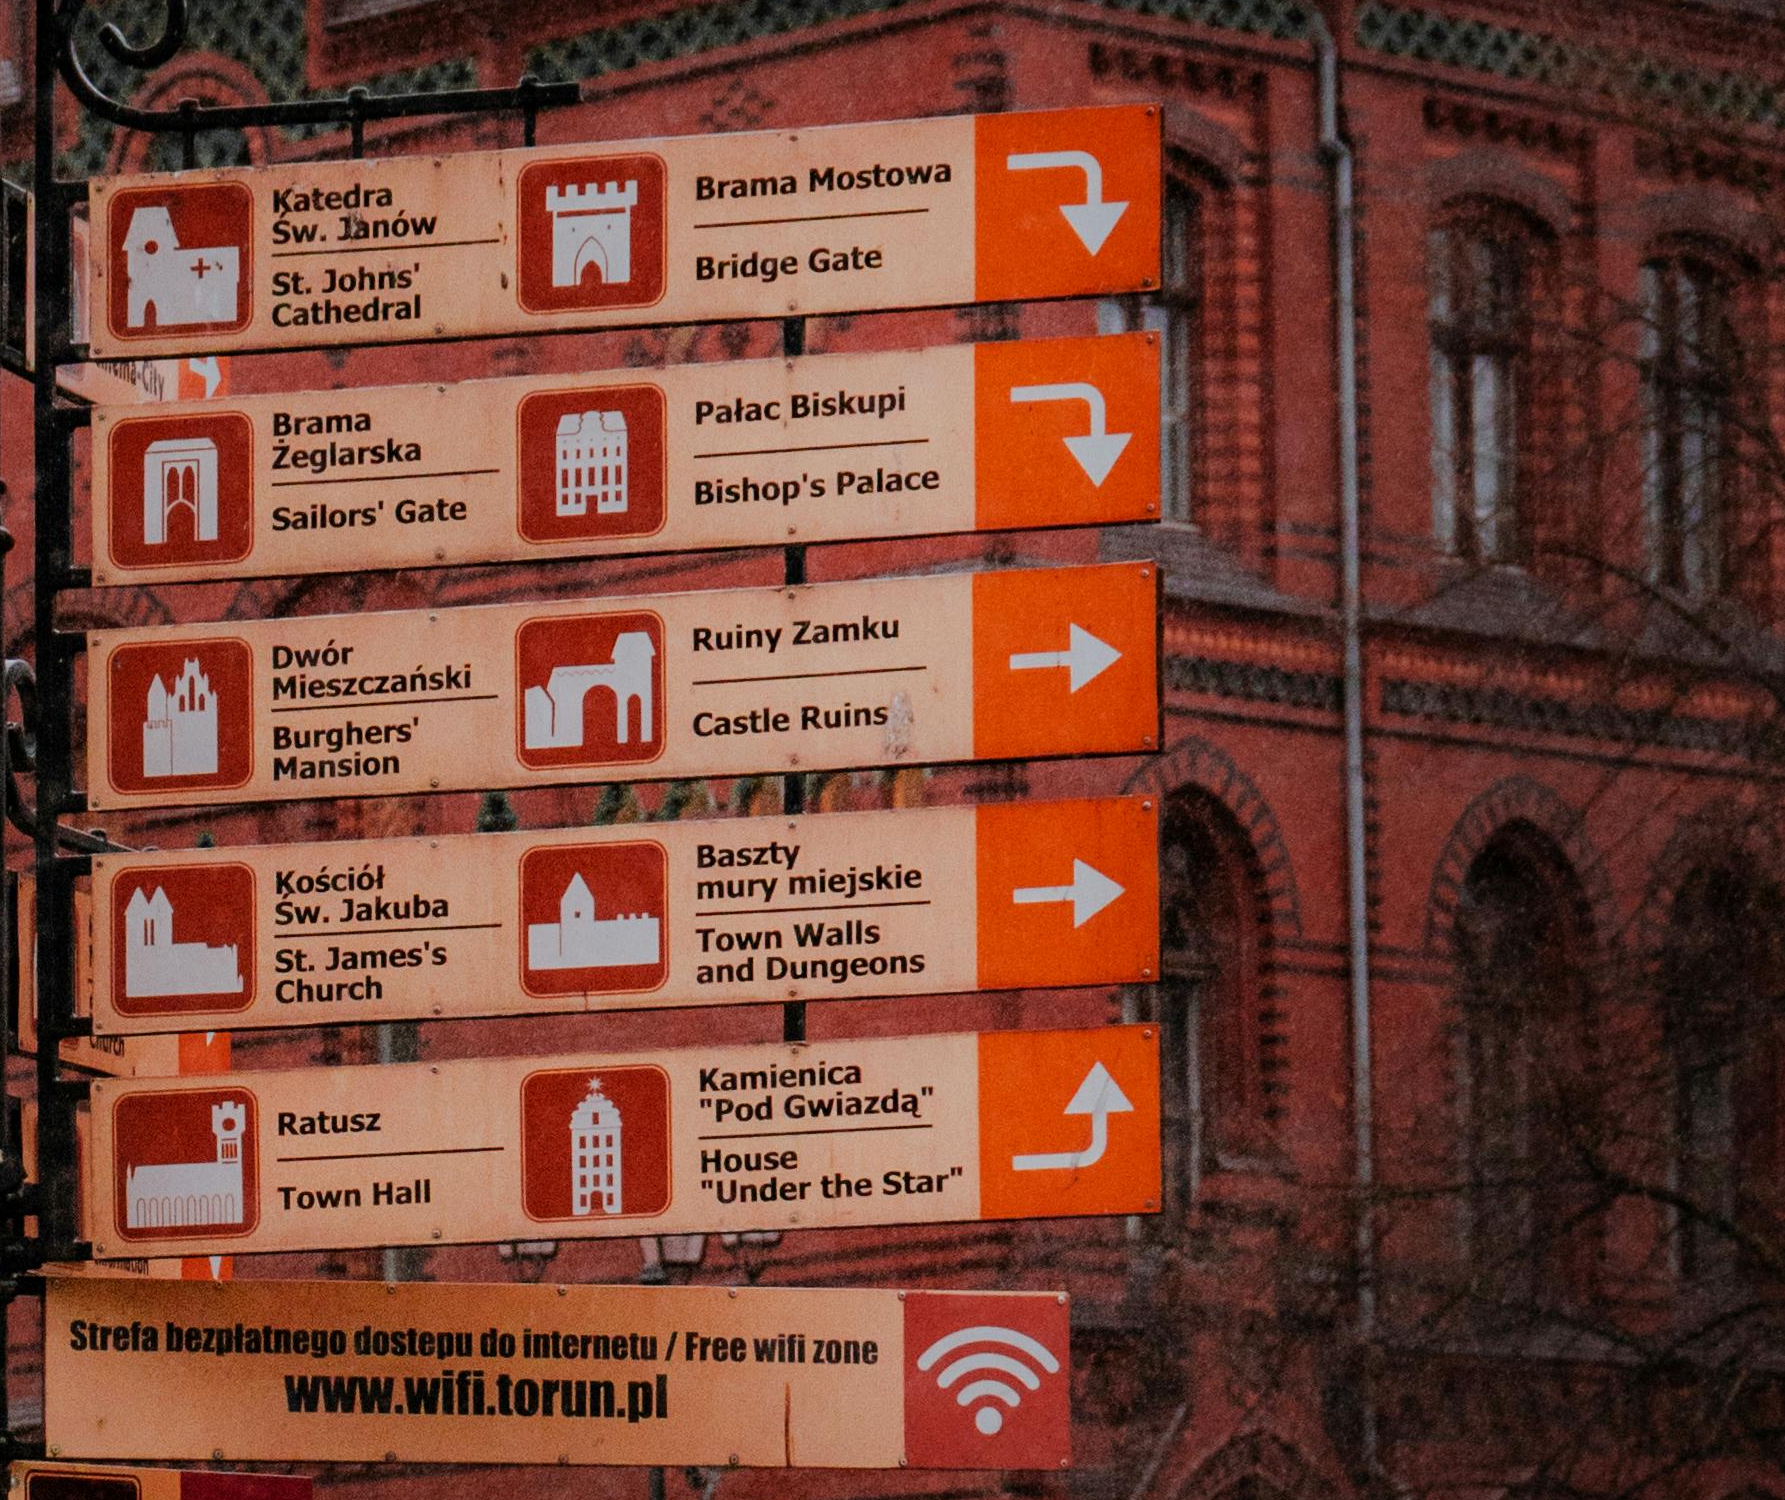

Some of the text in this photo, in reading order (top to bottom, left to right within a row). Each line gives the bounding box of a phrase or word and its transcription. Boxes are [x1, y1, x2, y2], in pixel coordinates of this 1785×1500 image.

[697, 164, 951, 200] Brama Mostowa
[274, 183, 392, 214] Katedra
[273, 210, 436, 244] Św. Janów
[272, 263, 419, 296] St. Johns'
[697, 247, 881, 282] Bridge Gate
[272, 295, 420, 327] Cathedral
[696, 386, 904, 424] Pałac Biskupi
[274, 413, 370, 436] Brama
[272, 438, 421, 473] Żeglarska
[695, 468, 939, 505] Bishop's Palace
[273, 499, 466, 531] Sailors' Gate
[694, 616, 898, 653] Ruiny Zamku
[273, 640, 353, 669] Dwór
[273, 664, 470, 700] Mieszczański
[693, 703, 888, 736] Castle Ruins
[274, 717, 418, 756] Burghers'
[274, 752, 399, 780] Mansion
[698, 842, 800, 870] Baszty
[276, 864, 385, 895] Kościół
[698, 865, 921, 902] mury miejskie
[276, 893, 448, 925] Św. Jakuba
[696, 920, 880, 952] Town Walls
[276, 942, 446, 973] St. James's
[697, 955, 924, 984] and Dungeons
[276, 976, 382, 1003] Church
[700, 1062, 861, 1092] Kamienica
[700, 1087, 933, 1122] "Pod Gwiazdą"
[279, 1112, 380, 1135] Ratusz
[701, 1150, 797, 1173] House
[278, 1179, 430, 1210] Town Hall
[702, 1167, 962, 1203] "Under the Star"
[71, 1320, 877, 1364] Strefa bezpłatnego dostepu do internetu / Free wifi zone
[285, 1370, 667, 1422] www.wifi.torun.pl
